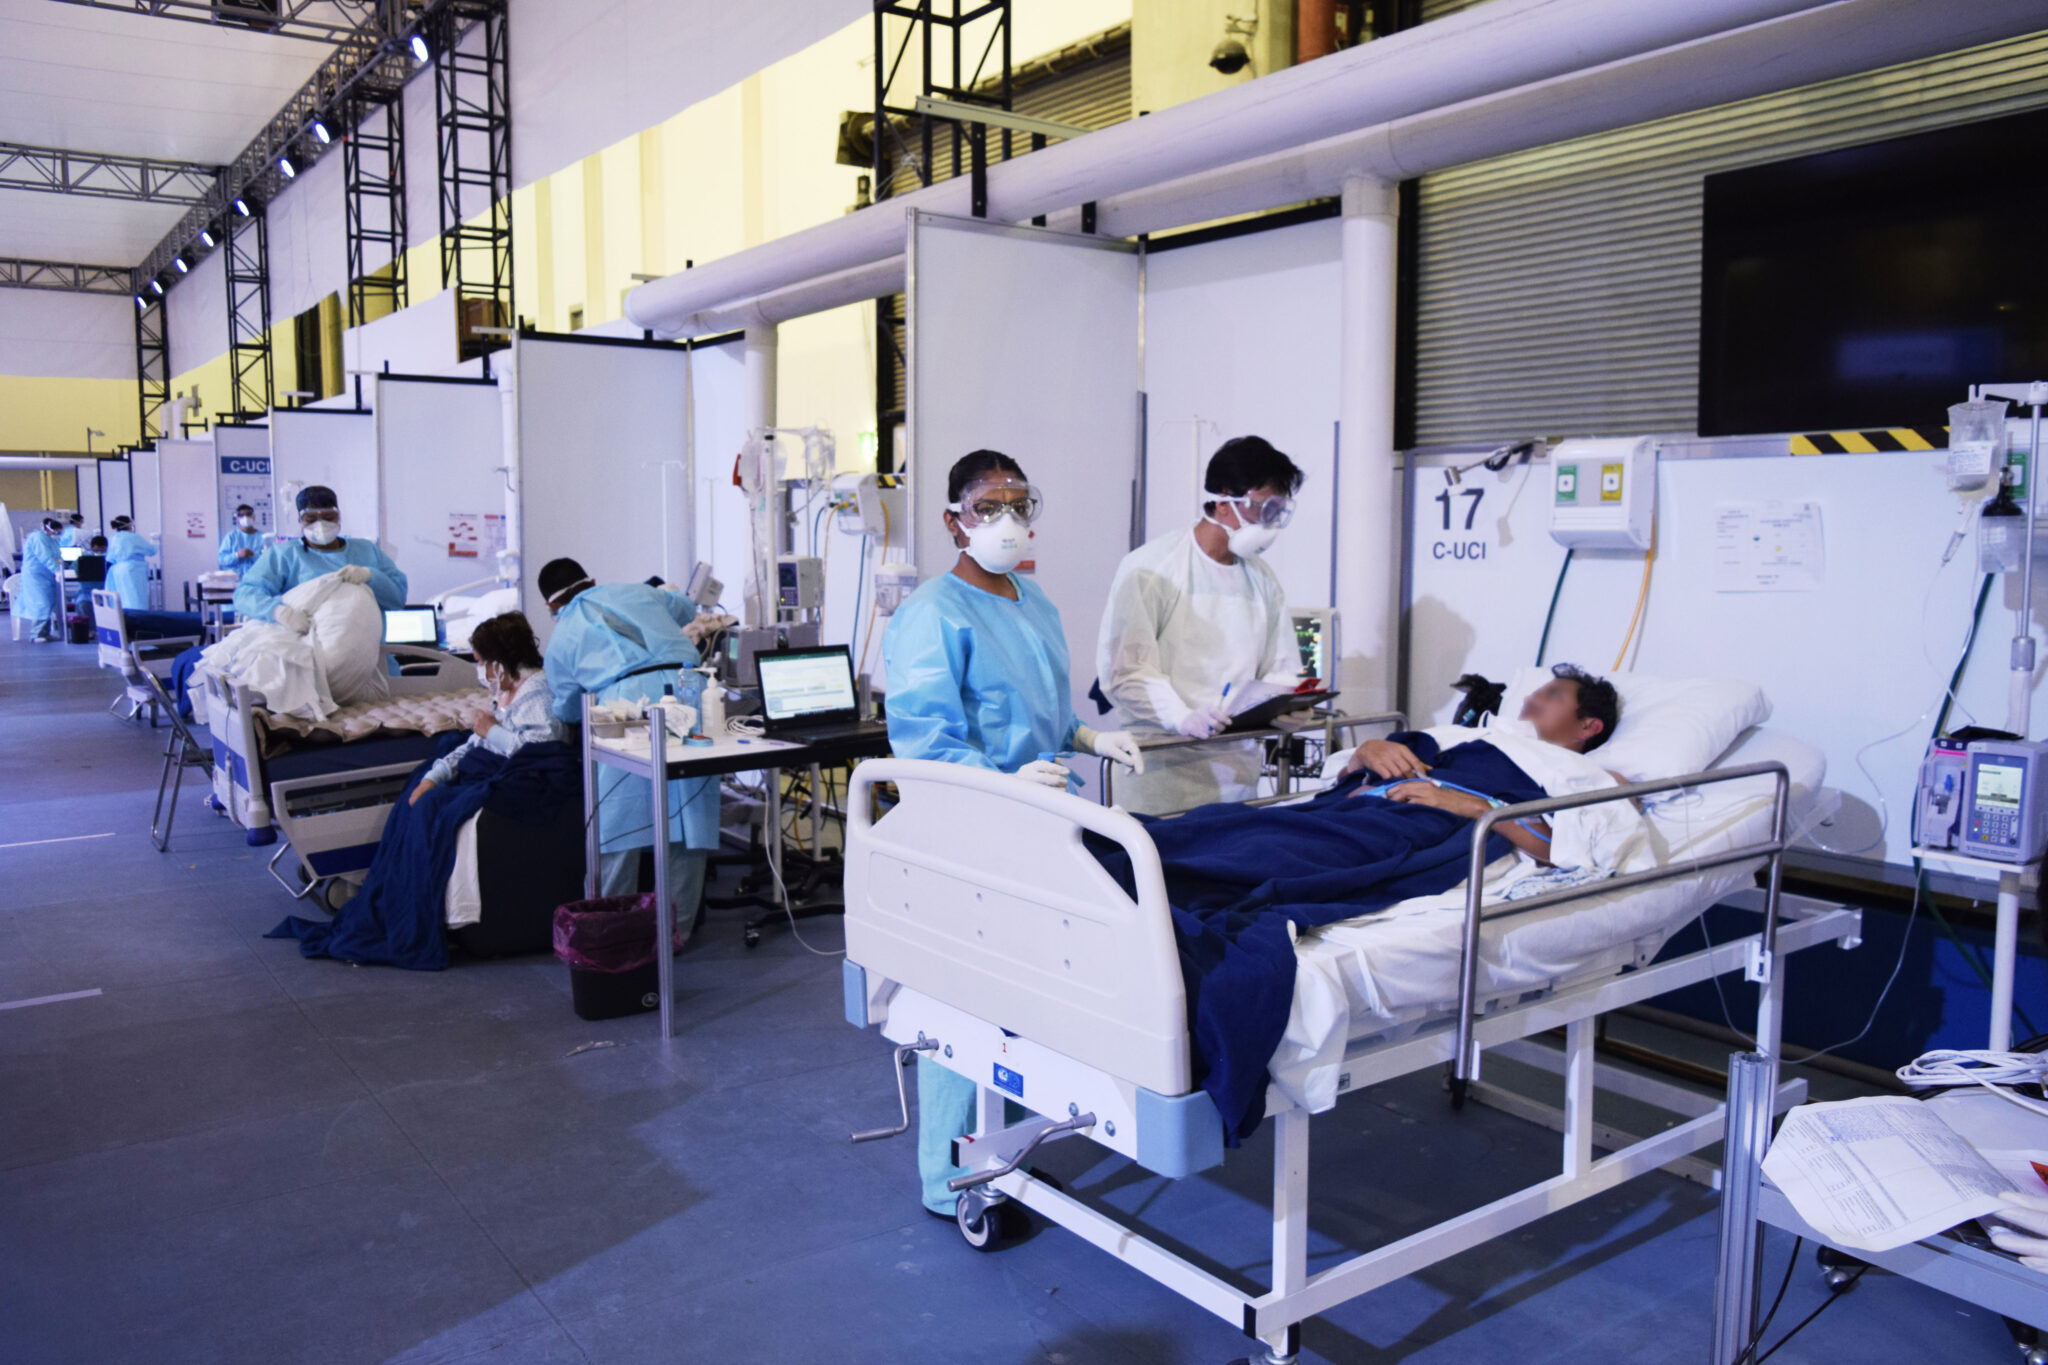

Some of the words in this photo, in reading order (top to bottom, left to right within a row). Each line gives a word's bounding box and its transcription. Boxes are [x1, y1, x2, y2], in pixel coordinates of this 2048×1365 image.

[230, 460, 270, 472] C-UCI
[1435, 488, 1484, 530] 17
[1432, 541, 1486, 560] C-UCI
